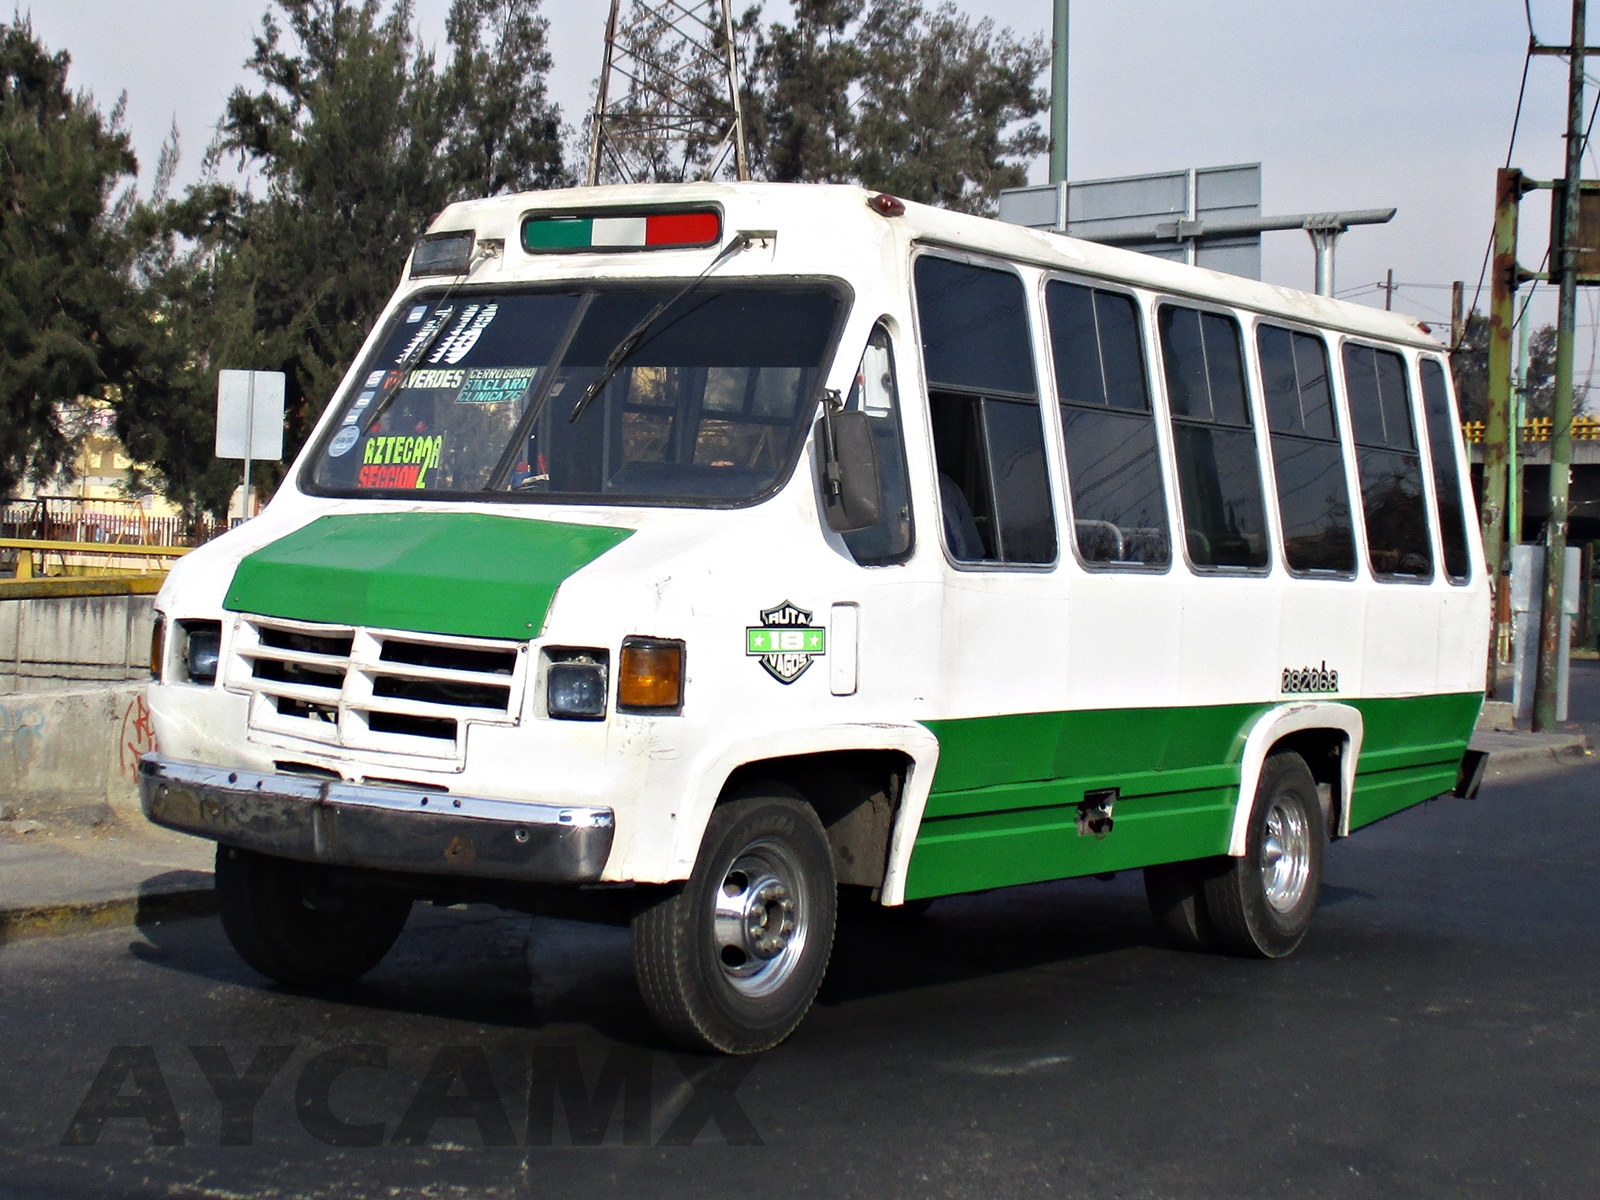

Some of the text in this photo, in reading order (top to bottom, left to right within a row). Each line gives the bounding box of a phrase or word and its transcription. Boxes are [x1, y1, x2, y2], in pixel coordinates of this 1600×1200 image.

[469, 368, 503, 379] CERRO
[363, 435, 424, 464] AZTECA
[357, 465, 420, 489] SECCION
[767, 607, 807, 625] RUTA
[769, 631, 805, 650] 18
[767, 654, 808, 678] VAGOS
